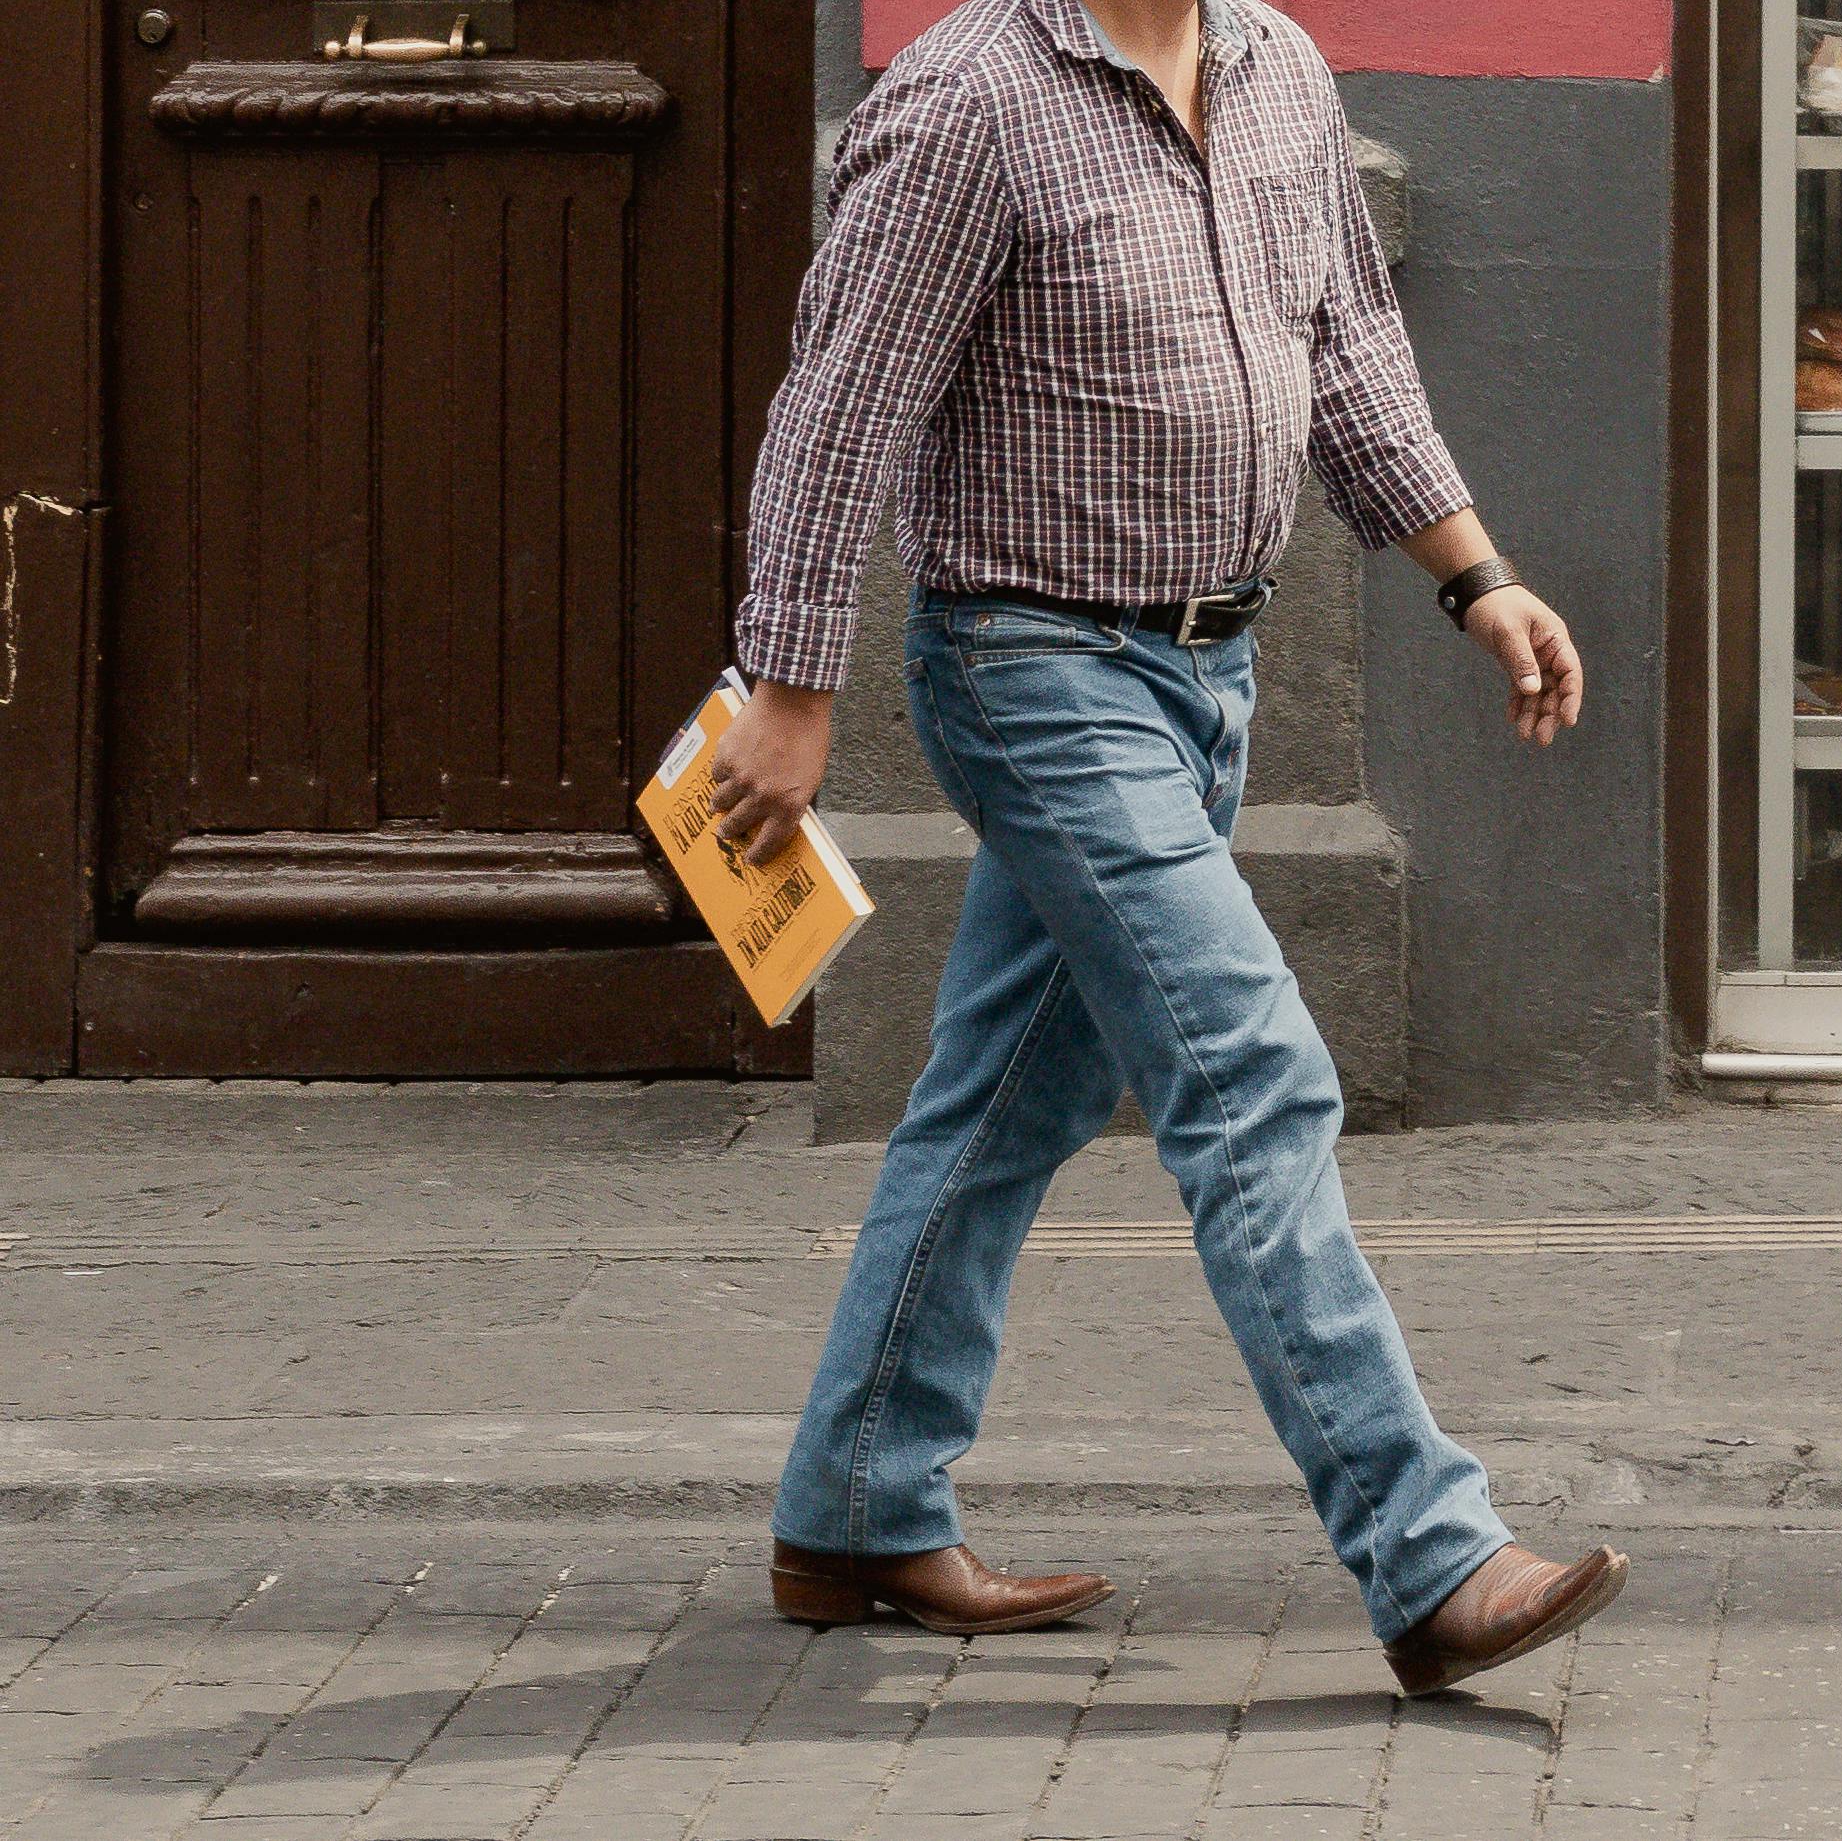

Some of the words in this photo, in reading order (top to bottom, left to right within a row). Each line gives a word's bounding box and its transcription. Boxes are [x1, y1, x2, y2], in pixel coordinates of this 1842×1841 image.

[670, 824, 691, 856] LA
[680, 803, 708, 843] ALTA
[747, 916, 774, 956] ALTA
[762, 862, 817, 935] CALIFORNIA
